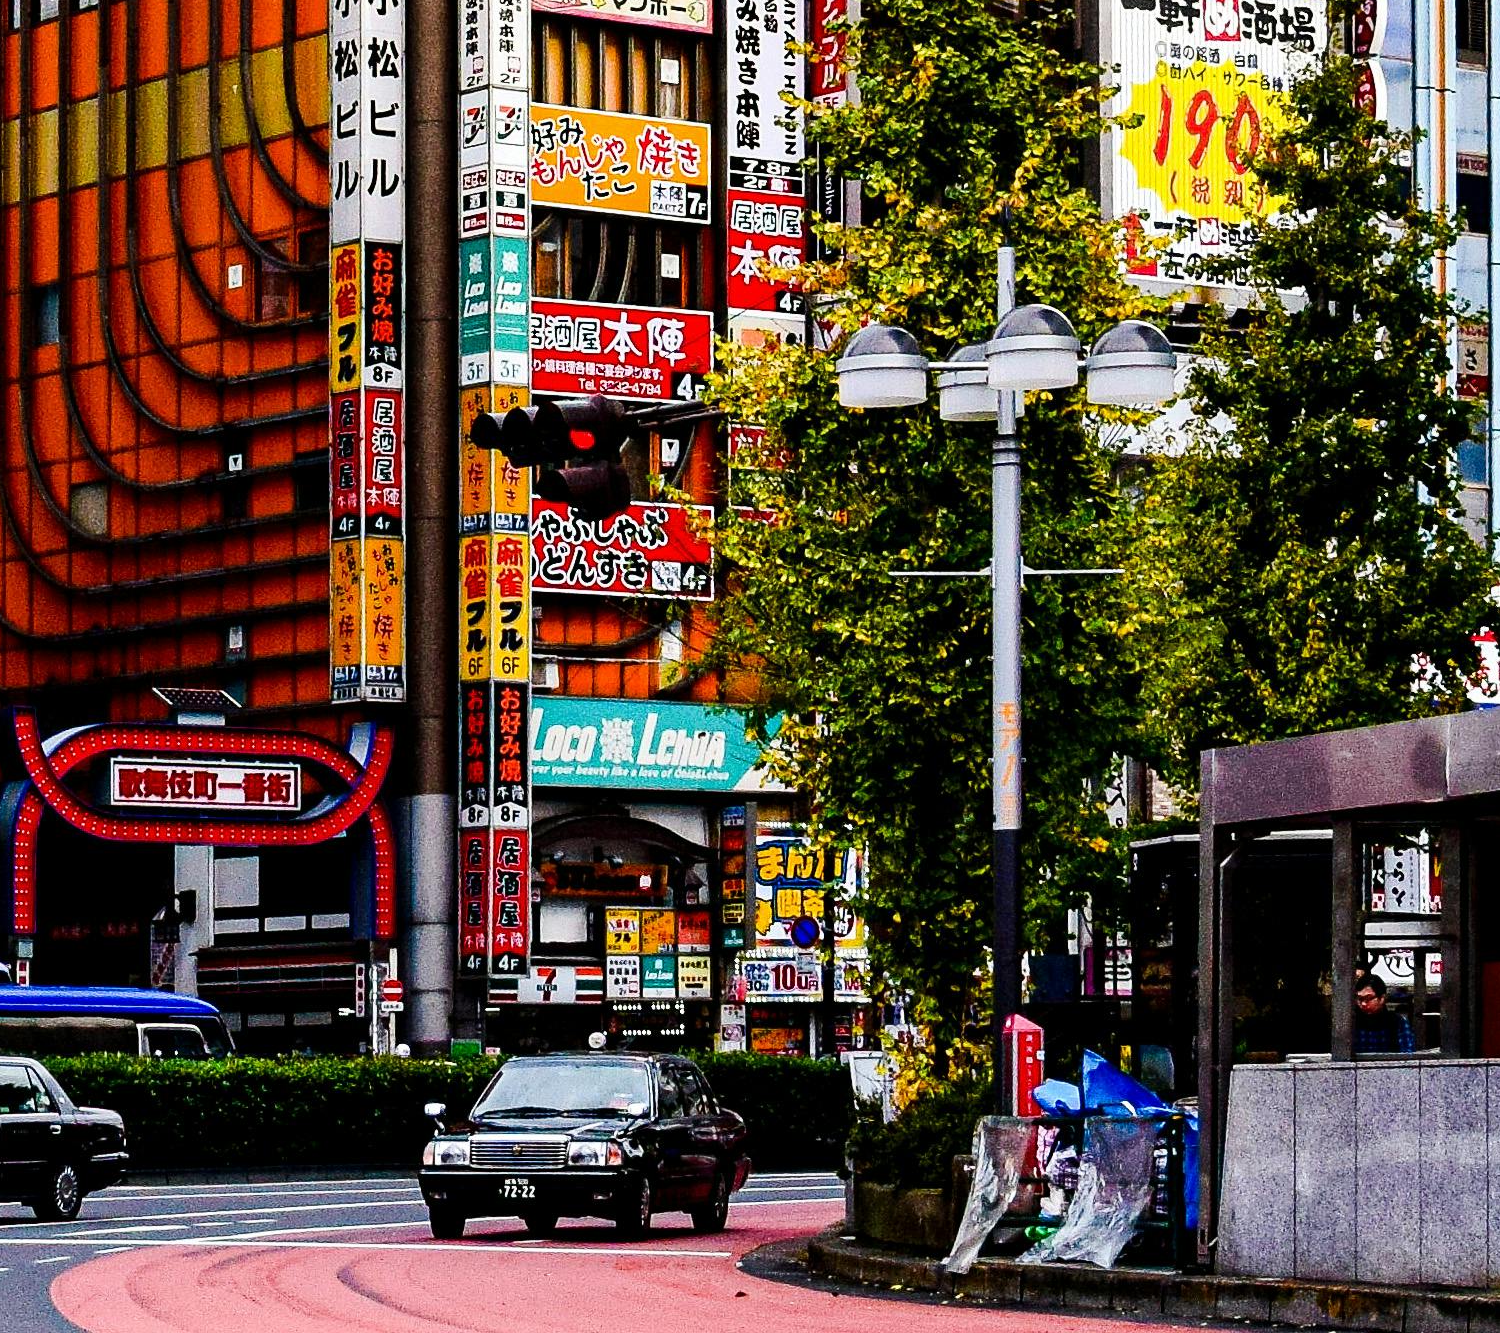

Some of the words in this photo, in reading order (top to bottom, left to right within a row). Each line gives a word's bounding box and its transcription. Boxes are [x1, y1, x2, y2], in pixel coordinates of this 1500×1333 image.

[1154, 85, 1262, 174] 190
[532, 118, 583, 154] 好み
[582, 164, 635, 200] たこ
[639, 128, 697, 175] 焼き
[688, 192, 707, 215] 7F
[731, 201, 803, 238] 居酒屋
[372, 249, 394, 343] お好み焼
[779, 294, 802, 312] 4F
[335, 249, 357, 382] 麻雀フル
[604, 312, 686, 366] 本陣
[372, 366, 392, 382] 8F
[467, 362, 484, 380] 3F
[500, 361, 520, 378] 3F
[372, 399, 395, 484] 居酒屋
[366, 488, 399, 506] 本陣
[340, 519, 354, 531] 4F
[375, 517, 390, 530] 4F
[464, 538, 486, 652] 麻雀フル
[496, 537, 524, 651] 麻雀フル
[468, 656, 484, 675] 6F
[501, 655, 519, 675] 6F
[466, 689, 484, 783] お好み焼
[499, 686, 522, 782] お好み焼
[118, 768, 292, 803] 歌舞伎町一番街
[467, 808, 484, 824] 8F
[500, 807, 520, 823] 8F
[466, 837, 483, 928] 居酒屋
[498, 836, 522, 928] 居酒屋
[467, 955, 481, 971] 4F
[498, 957, 518, 972] 4F
